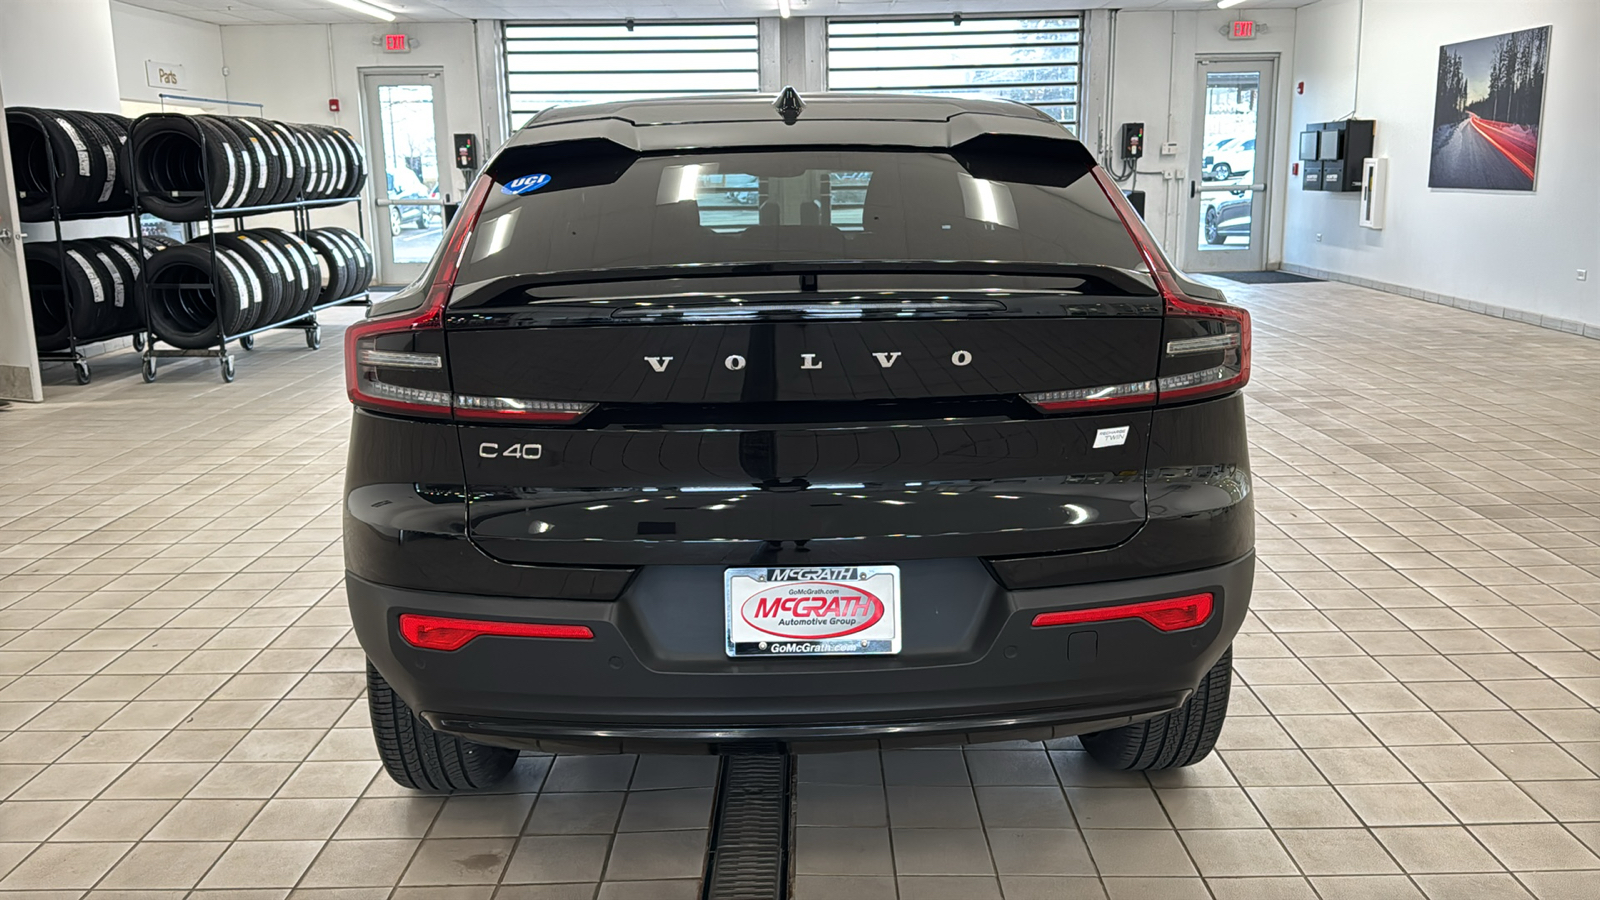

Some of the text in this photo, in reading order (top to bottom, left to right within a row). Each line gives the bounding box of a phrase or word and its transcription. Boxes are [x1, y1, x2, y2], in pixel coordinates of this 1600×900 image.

[1234, 21, 1253, 37] EXIT
[386, 34, 405, 50] EXIT
[159, 68, 177, 84] Parts
[644, 350, 973, 372] VOLVO
[788, 588, 840, 596] GoMcGrath.com
[778, 617, 857, 627] Automotive Group
[770, 642, 858, 653] GoMcGrath.com
